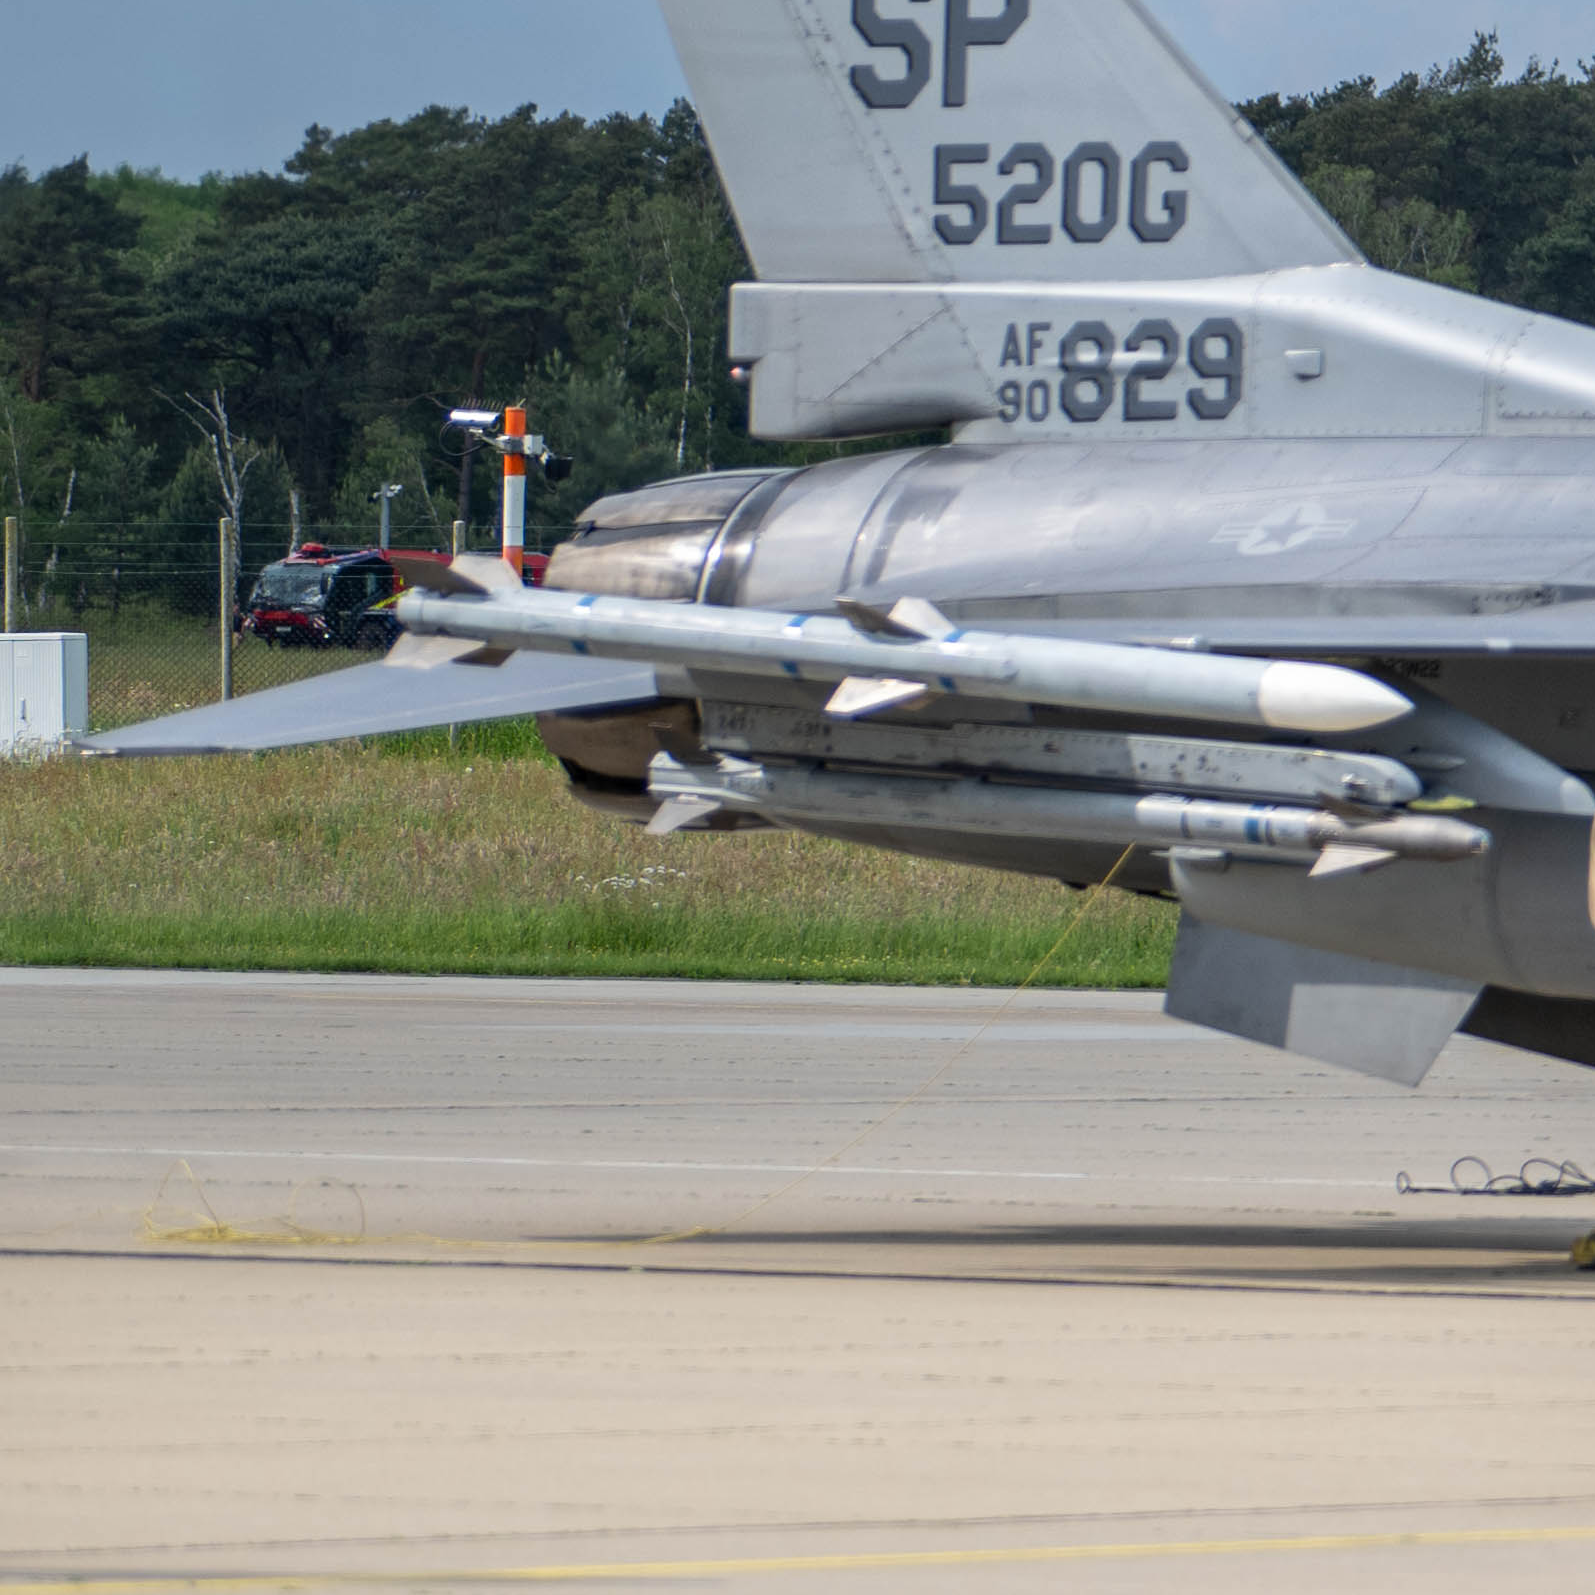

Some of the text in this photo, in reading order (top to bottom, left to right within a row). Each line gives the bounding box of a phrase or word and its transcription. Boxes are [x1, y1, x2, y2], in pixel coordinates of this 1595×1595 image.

[931, 141, 1190, 247] 520G
[998, 322, 1052, 368] AF
[1058, 317, 1245, 423] 829
[997, 379, 1051, 424] 90
